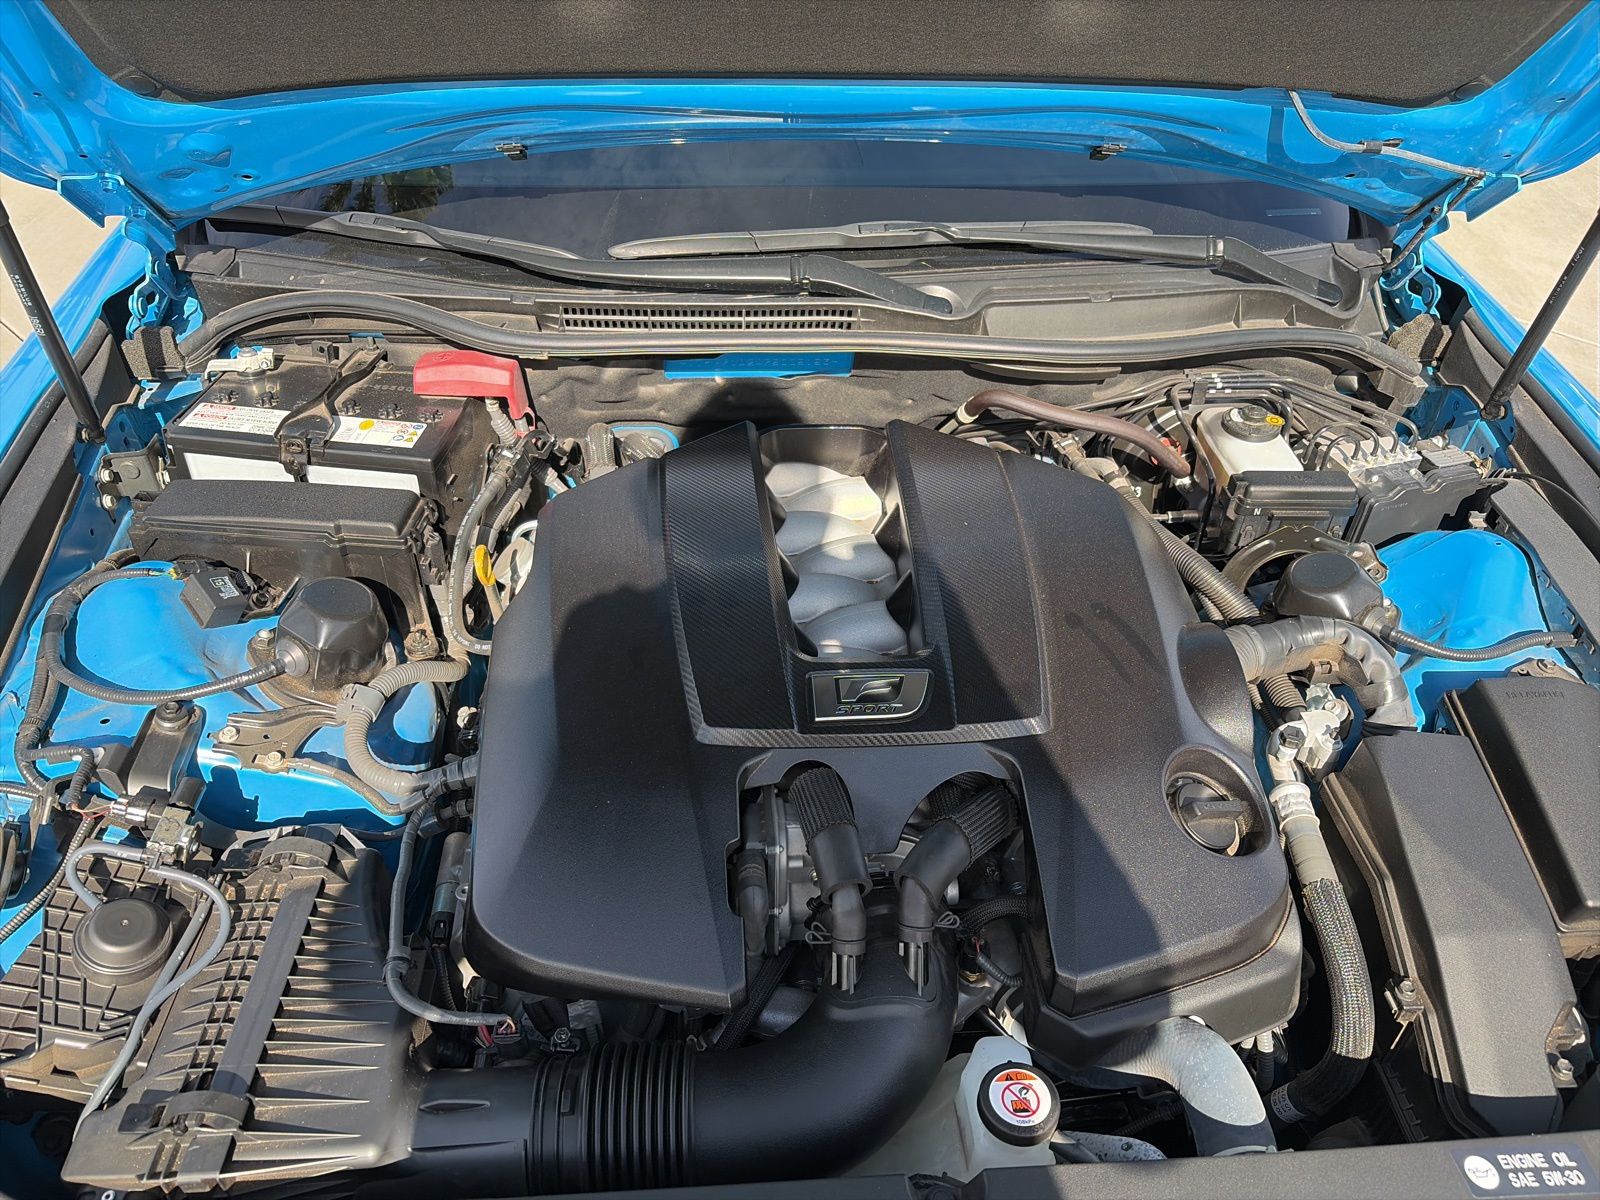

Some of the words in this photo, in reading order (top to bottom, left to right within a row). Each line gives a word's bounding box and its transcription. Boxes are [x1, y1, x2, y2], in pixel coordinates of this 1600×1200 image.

[1253, 507, 1262, 516] N
[835, 703, 903, 715] SPORT
[1496, 1152, 1549, 1170] ENGINE
[1551, 1151, 1577, 1168] OIL
[1508, 1171, 1540, 1188] SAE
[1541, 1170, 1586, 1187] 5W-30
